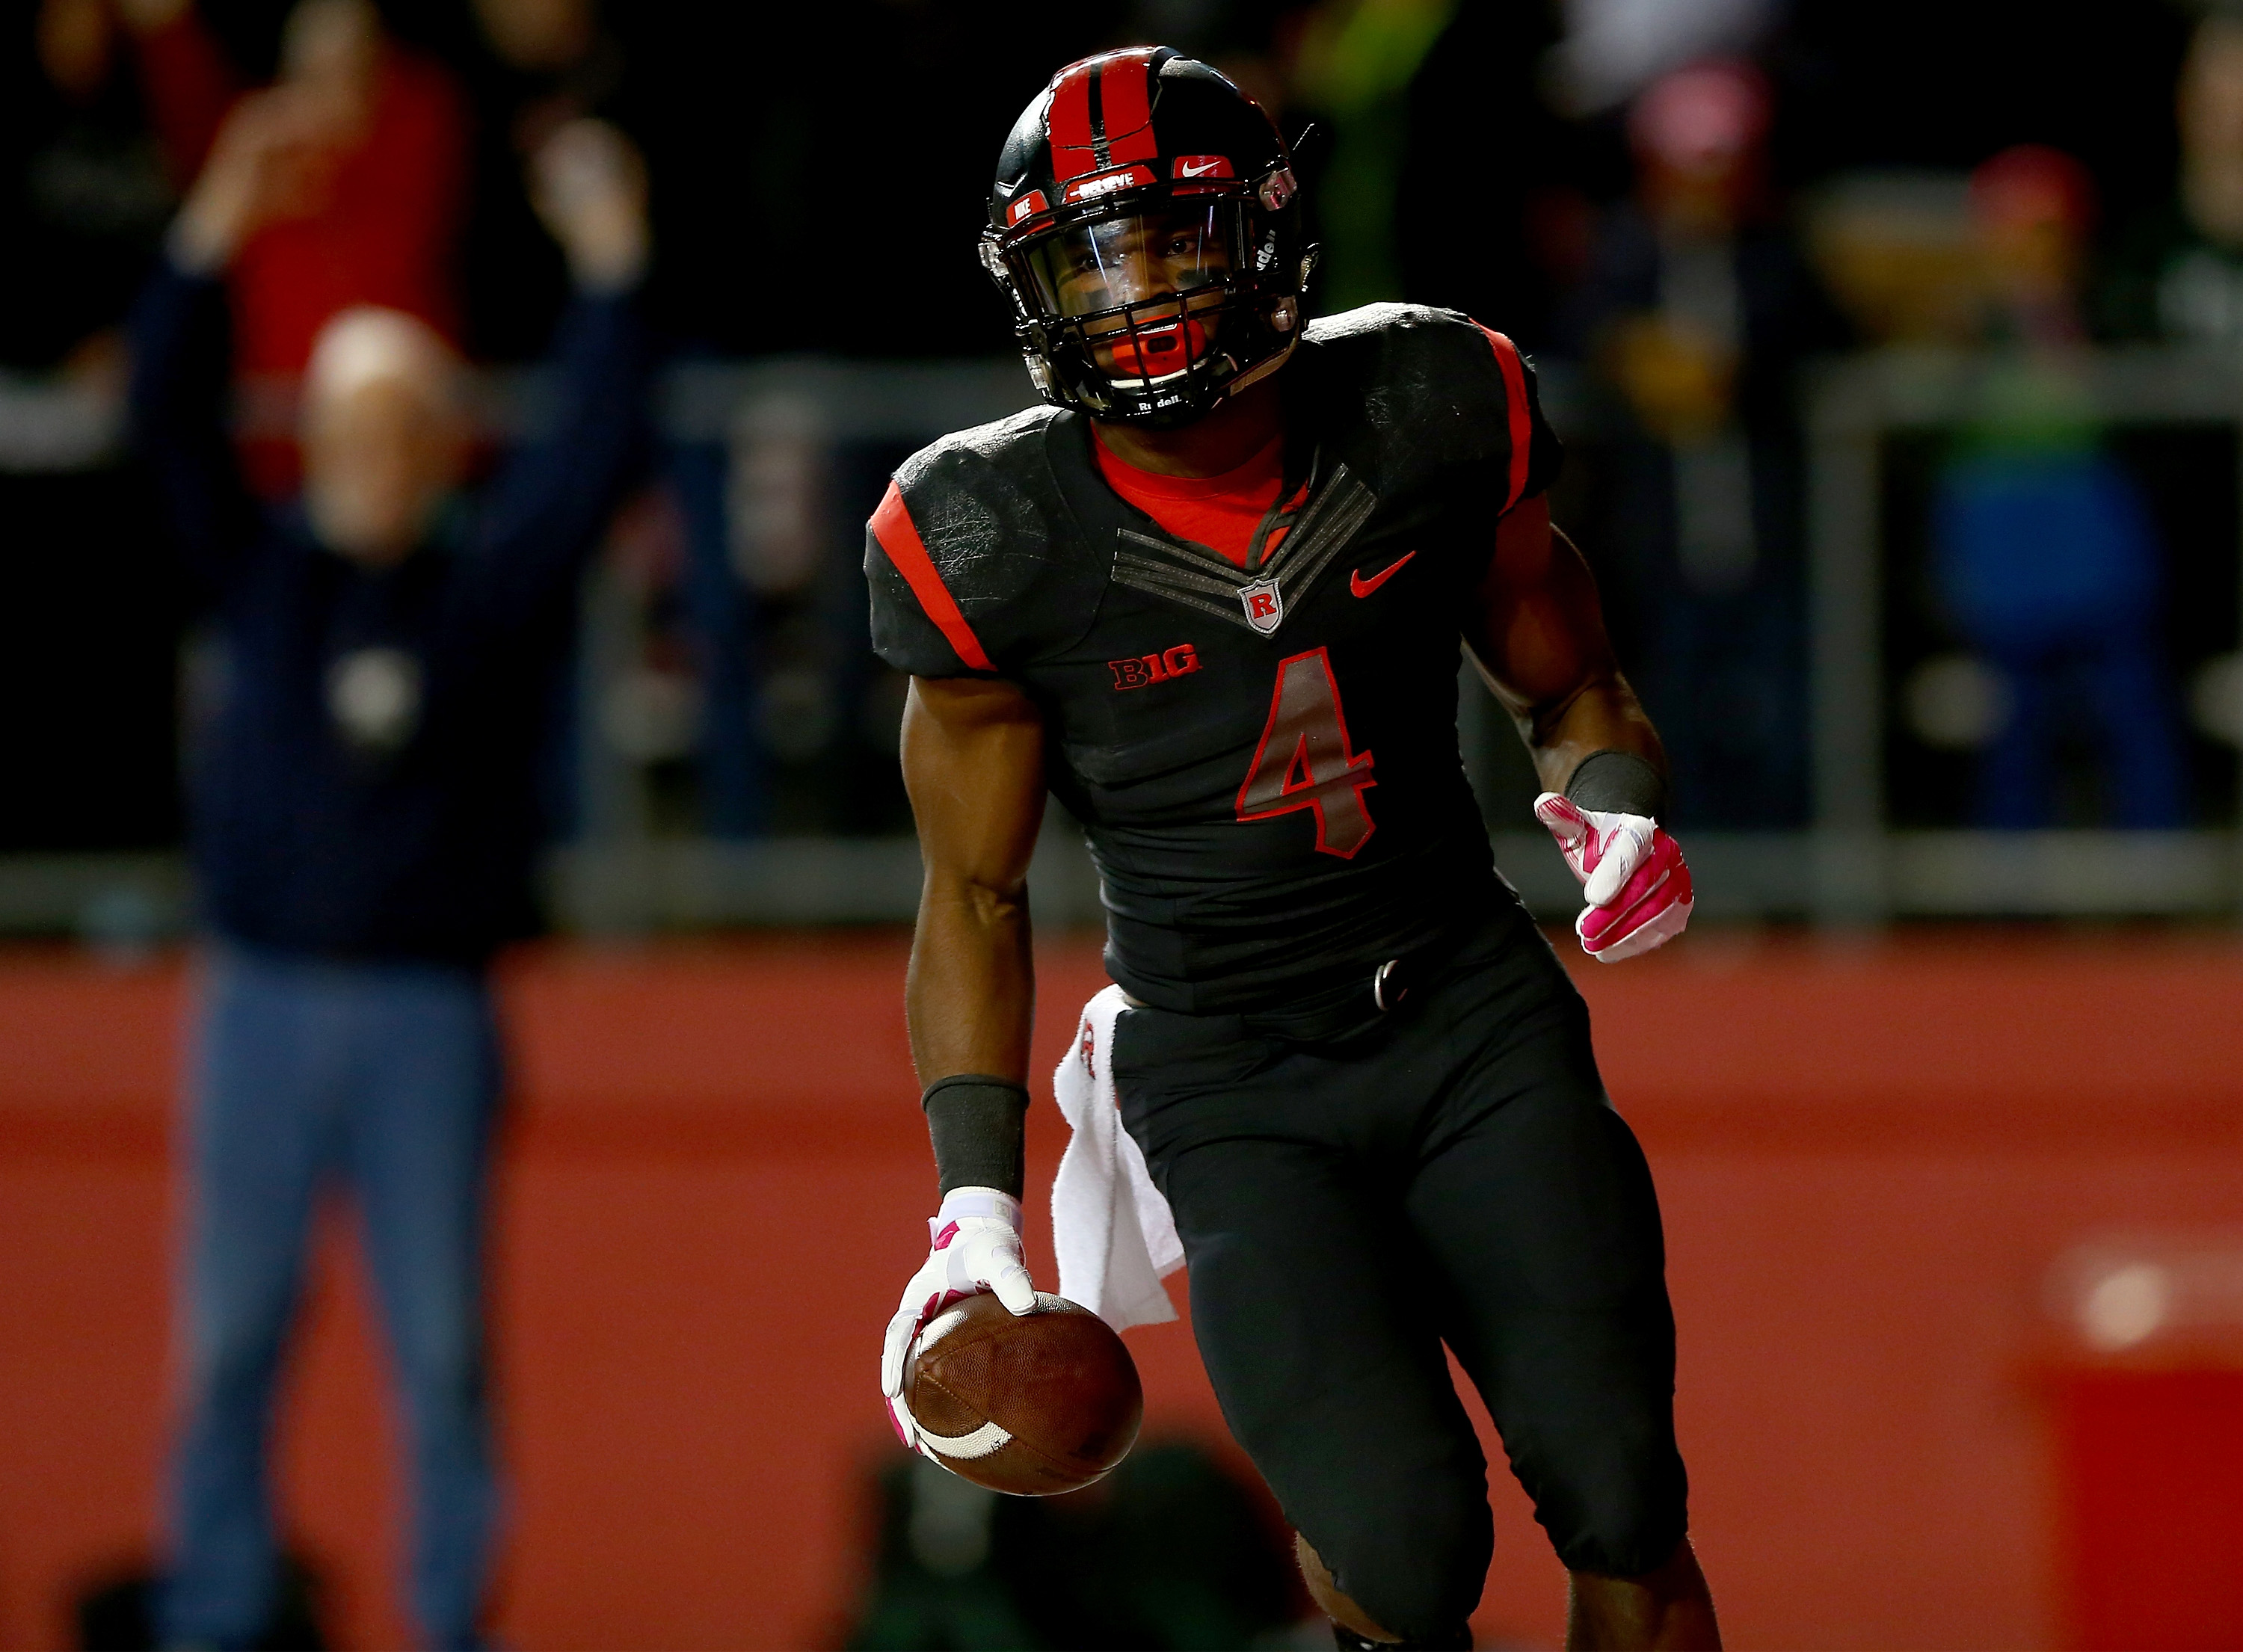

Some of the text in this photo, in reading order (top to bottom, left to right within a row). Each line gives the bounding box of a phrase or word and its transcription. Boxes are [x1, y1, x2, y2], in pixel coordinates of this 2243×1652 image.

[1015, 197, 1031, 220] NIKE
[1139, 395, 1180, 410] Ridell
[1249, 594, 1277, 619] R
[1235, 646, 1377, 860] 4
